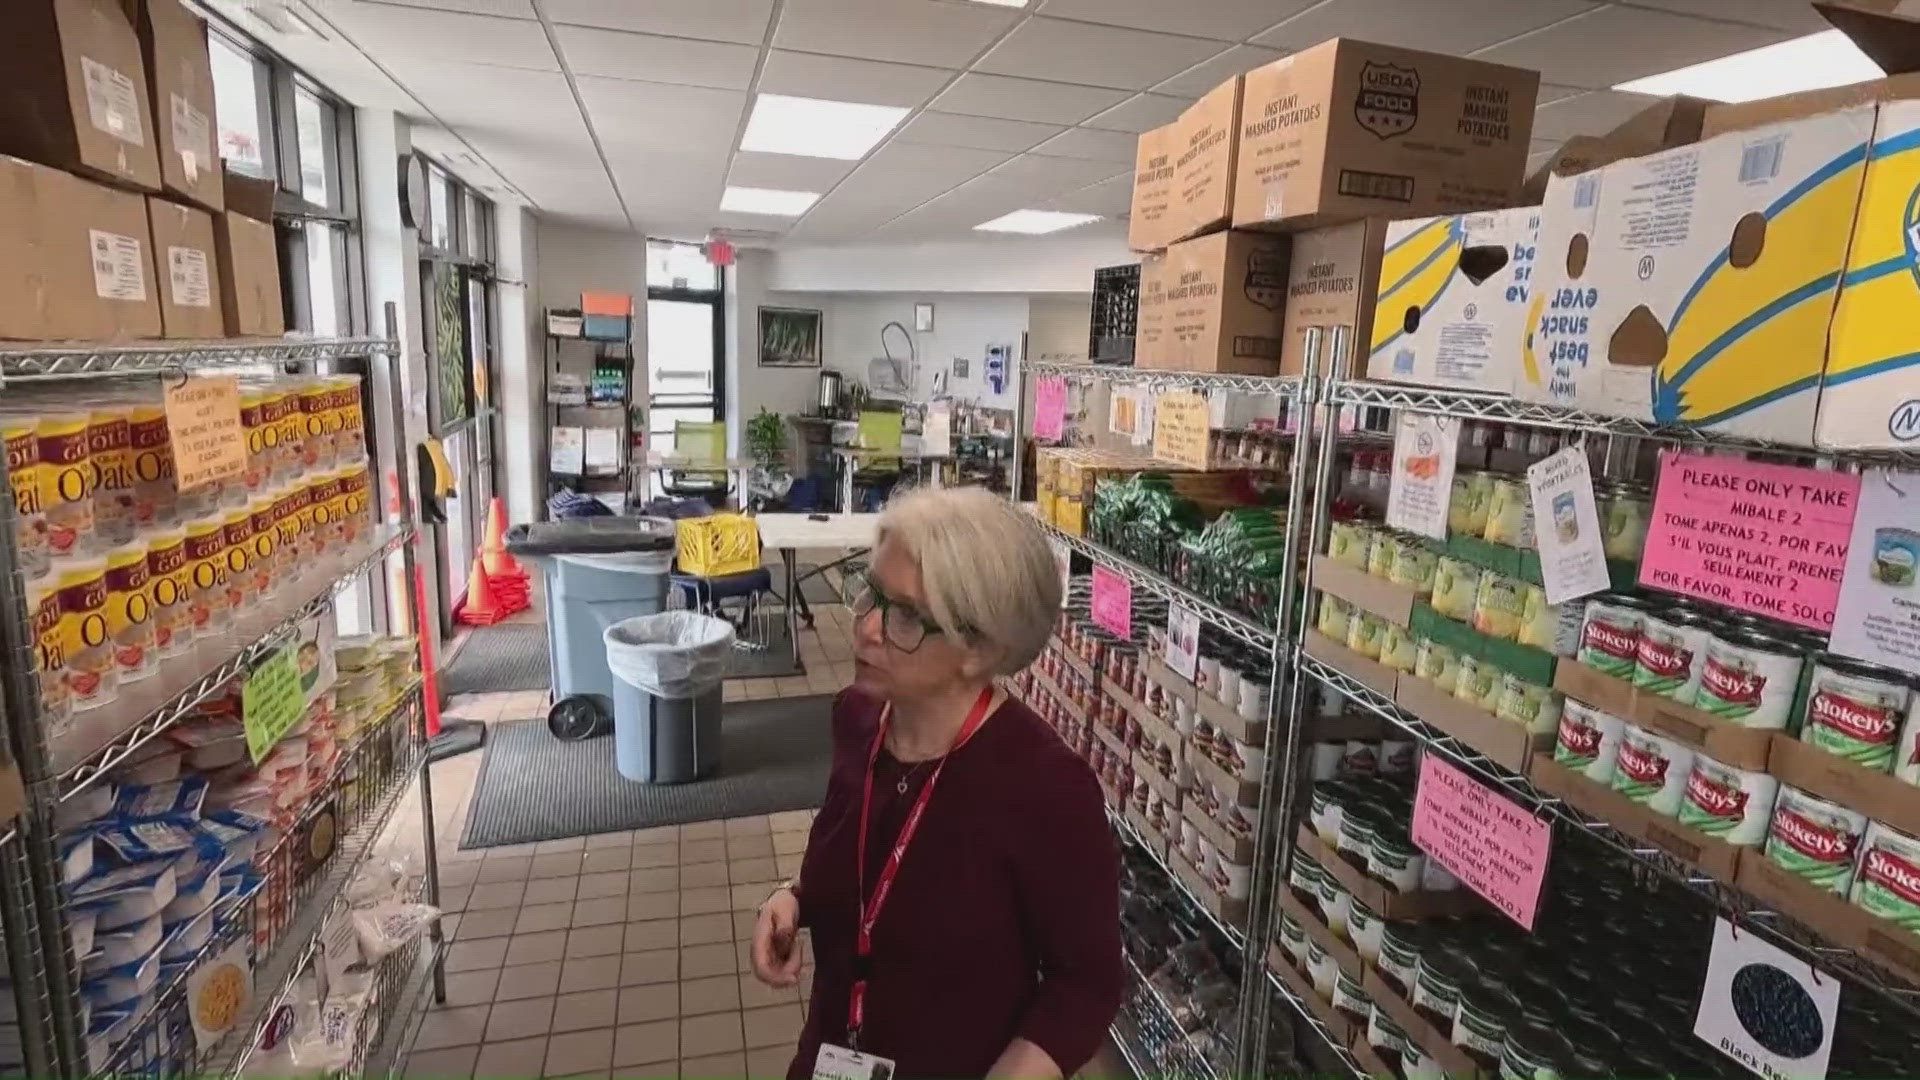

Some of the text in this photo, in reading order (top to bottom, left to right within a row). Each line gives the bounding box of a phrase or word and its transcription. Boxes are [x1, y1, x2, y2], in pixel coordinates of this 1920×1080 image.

[1366, 71, 1414, 89] USDA
[1263, 94, 1299, 118] INSTANT
[1363, 93, 1413, 112] FOOD
[1466, 85, 1510, 104] INSTANT
[1245, 103, 1321, 139] MASHED POTATOES
[1463, 102, 1509, 122] MASHED
[1456, 119, 1510, 141] POTATOES
[1513, 242, 1536, 262] be
[1307, 262, 1336, 282] INSTANT
[1551, 287, 1599, 310] ever
[1539, 315, 1590, 340] snack
[1549, 340, 1590, 369] best
[1549, 380, 1577, 399] likely
[1682, 469, 1850, 507] PLEASE ONLY TAKE
[1731, 501, 1802, 526] MIBALE 2
[1664, 513, 1698, 530] TOME
[1702, 520, 1754, 540] APENAS
[1779, 535, 1810, 552] POR
[1815, 541, 1848, 558] FAV
[1670, 535, 1692, 550] S'IL
[1697, 541, 1732, 559] VOUS
[1788, 559, 1842, 583] PRENE
[1703, 559, 1799, 592] SEULEMENT 2
[1653, 569, 1836, 625] POR FAVOR, TOME SOLO
[1434, 767, 1465, 795] PLEASE
[1468, 787, 1493, 811] ONLY
[1497, 804, 1523, 832] TAKE
[1526, 825, 1532, 836] 2
[1424, 797, 1442, 814] TOME
[1485, 836, 1501, 855] POR
[1503, 846, 1533, 875] FAVOR
[1465, 870, 1487, 892] TOME
[1490, 888, 1514, 912] SOLO
[1517, 907, 1523, 918] 2
[1720, 1036, 1759, 1070] Black
